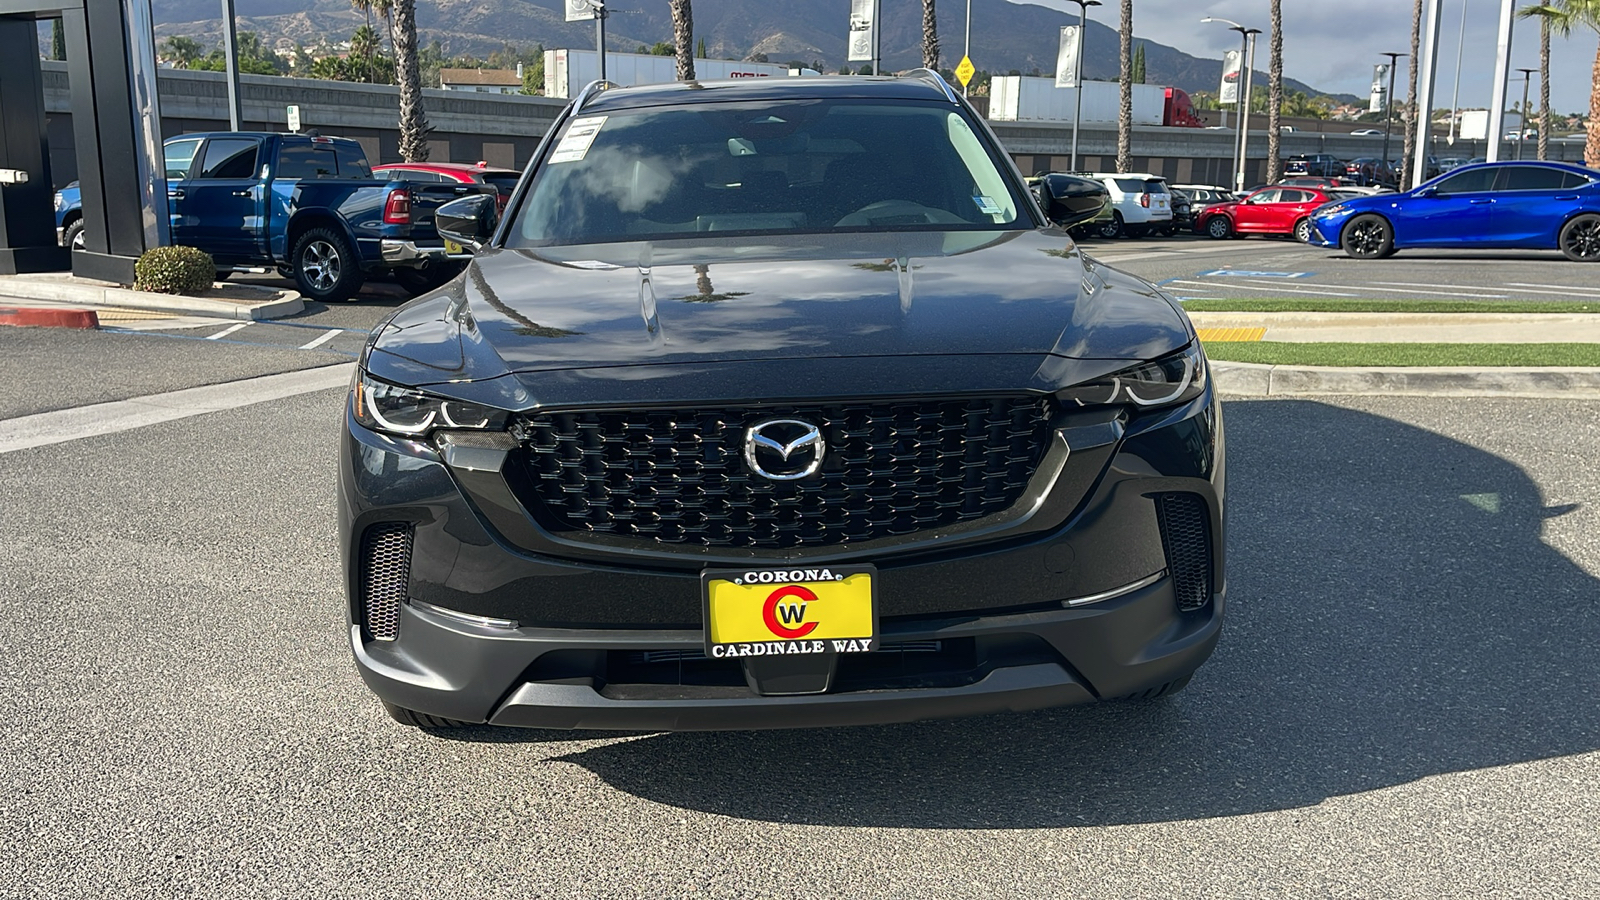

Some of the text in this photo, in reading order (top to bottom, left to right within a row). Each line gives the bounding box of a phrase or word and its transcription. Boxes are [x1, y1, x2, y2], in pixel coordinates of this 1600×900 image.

[744, 568, 834, 583] CORONA
[712, 638, 873, 658] CARDINALE WAY
